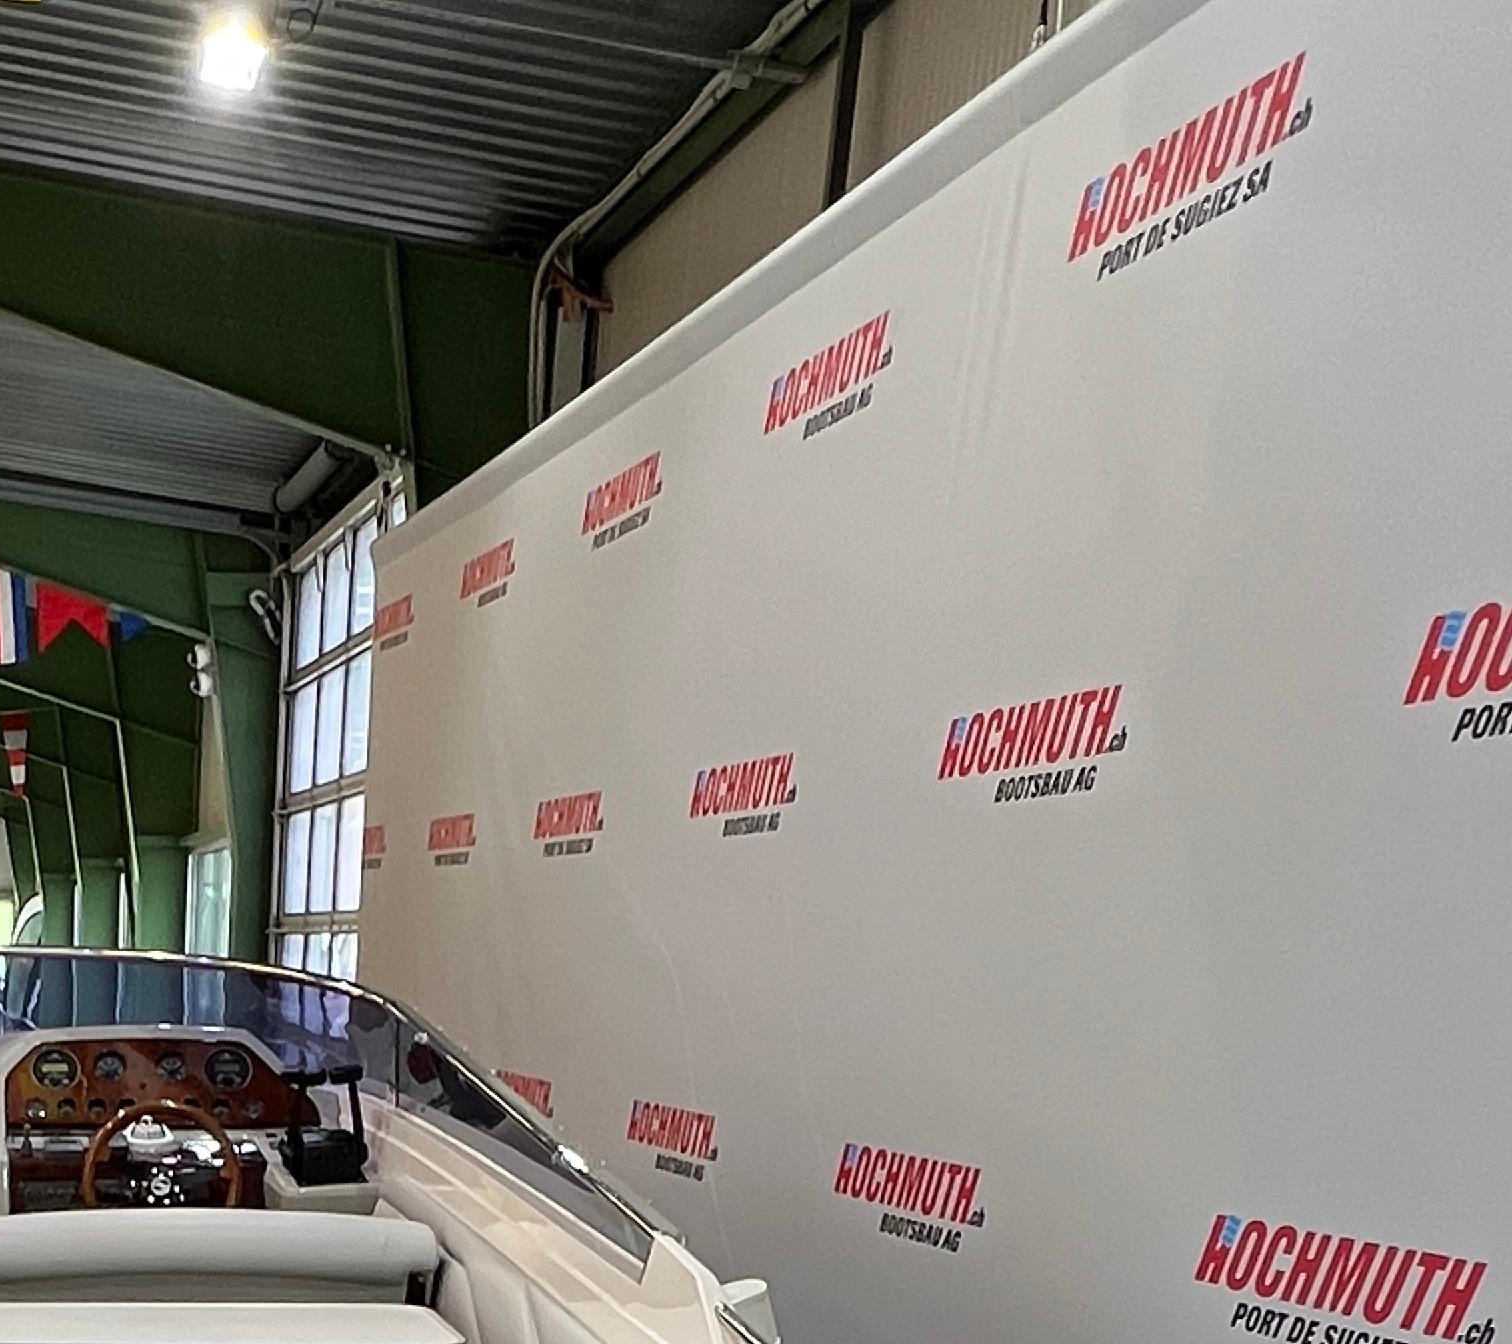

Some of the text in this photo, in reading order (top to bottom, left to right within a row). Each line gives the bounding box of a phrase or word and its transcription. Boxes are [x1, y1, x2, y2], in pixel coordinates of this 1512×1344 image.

[1097, 159, 1273, 282] PORT DE SUGIEZ SA
[994, 765, 1098, 803] BOOTSBAU AG
[879, 1212, 962, 1253] BOOTSBAU AG
[1231, 1302, 1290, 1339] PORT
